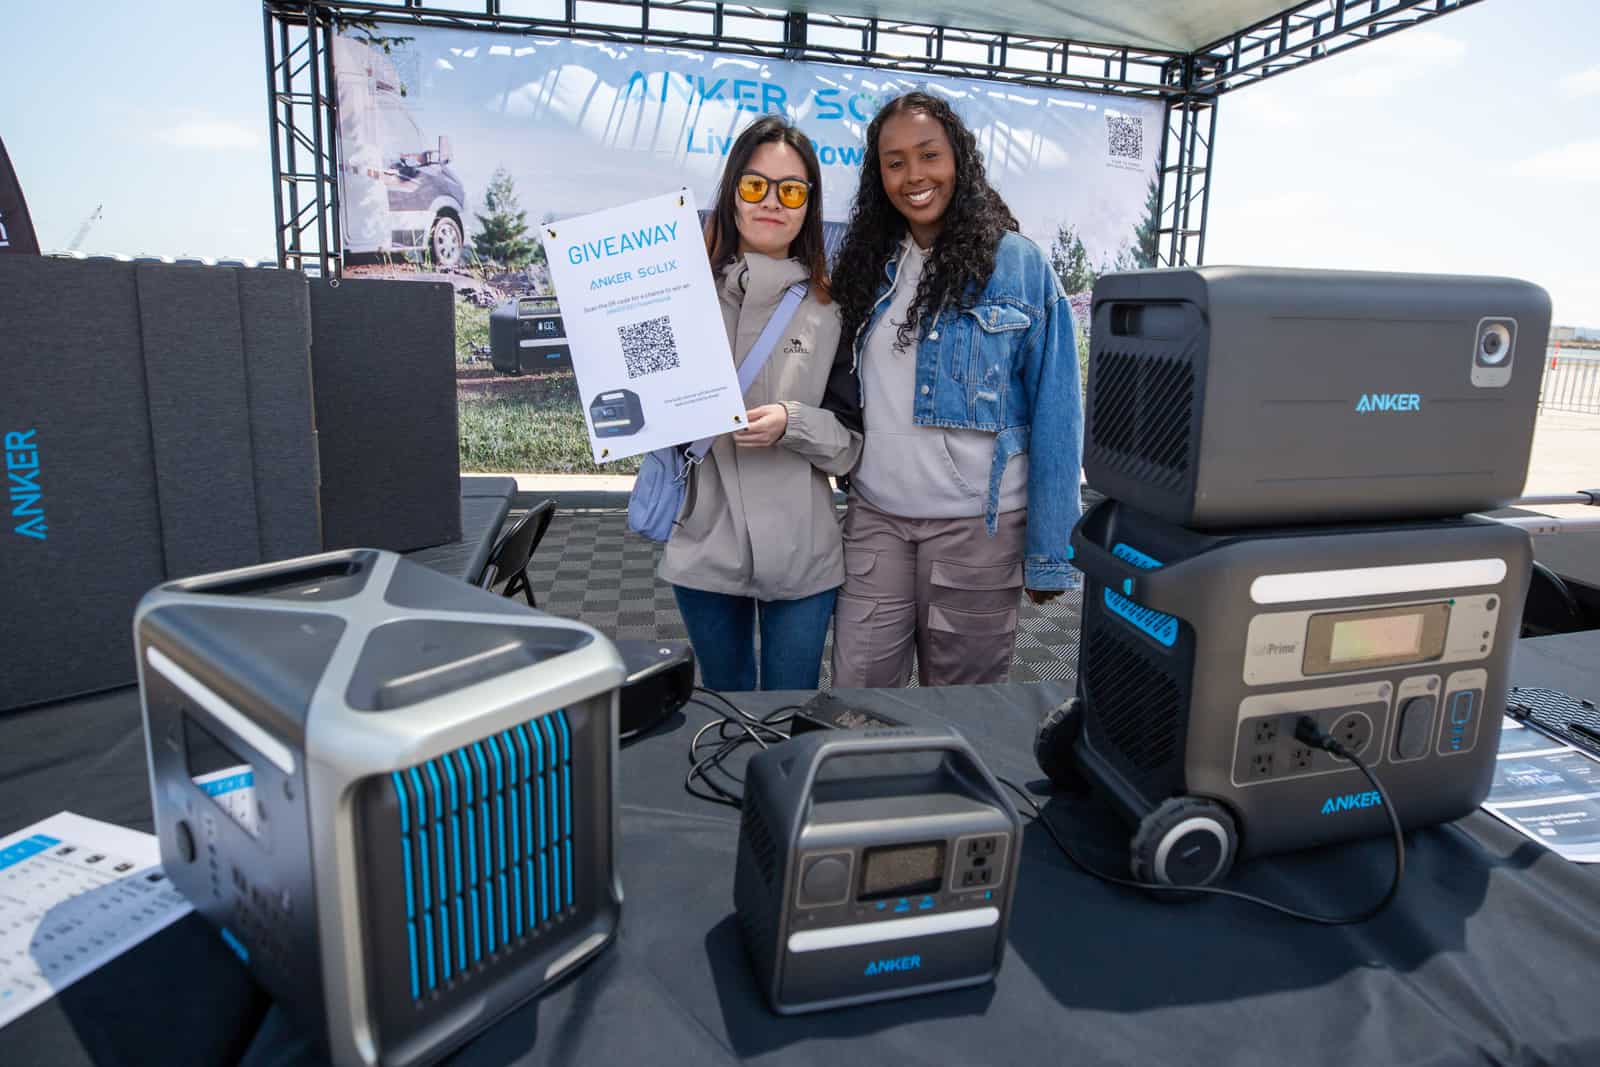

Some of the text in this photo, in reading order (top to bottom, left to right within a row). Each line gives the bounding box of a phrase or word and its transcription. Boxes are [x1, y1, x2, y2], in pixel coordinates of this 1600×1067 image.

[621, 70, 787, 115] ANKER
[687, 127, 734, 156] Liv
[568, 220, 678, 265] GIVEAWAY
[590, 260, 678, 291] ANKER SOLIX
[1355, 394, 1421, 412] ANKER
[3, 428, 48, 540] ANKER
[1321, 790, 1382, 815] ANKER
[864, 954, 921, 976] ANKER
